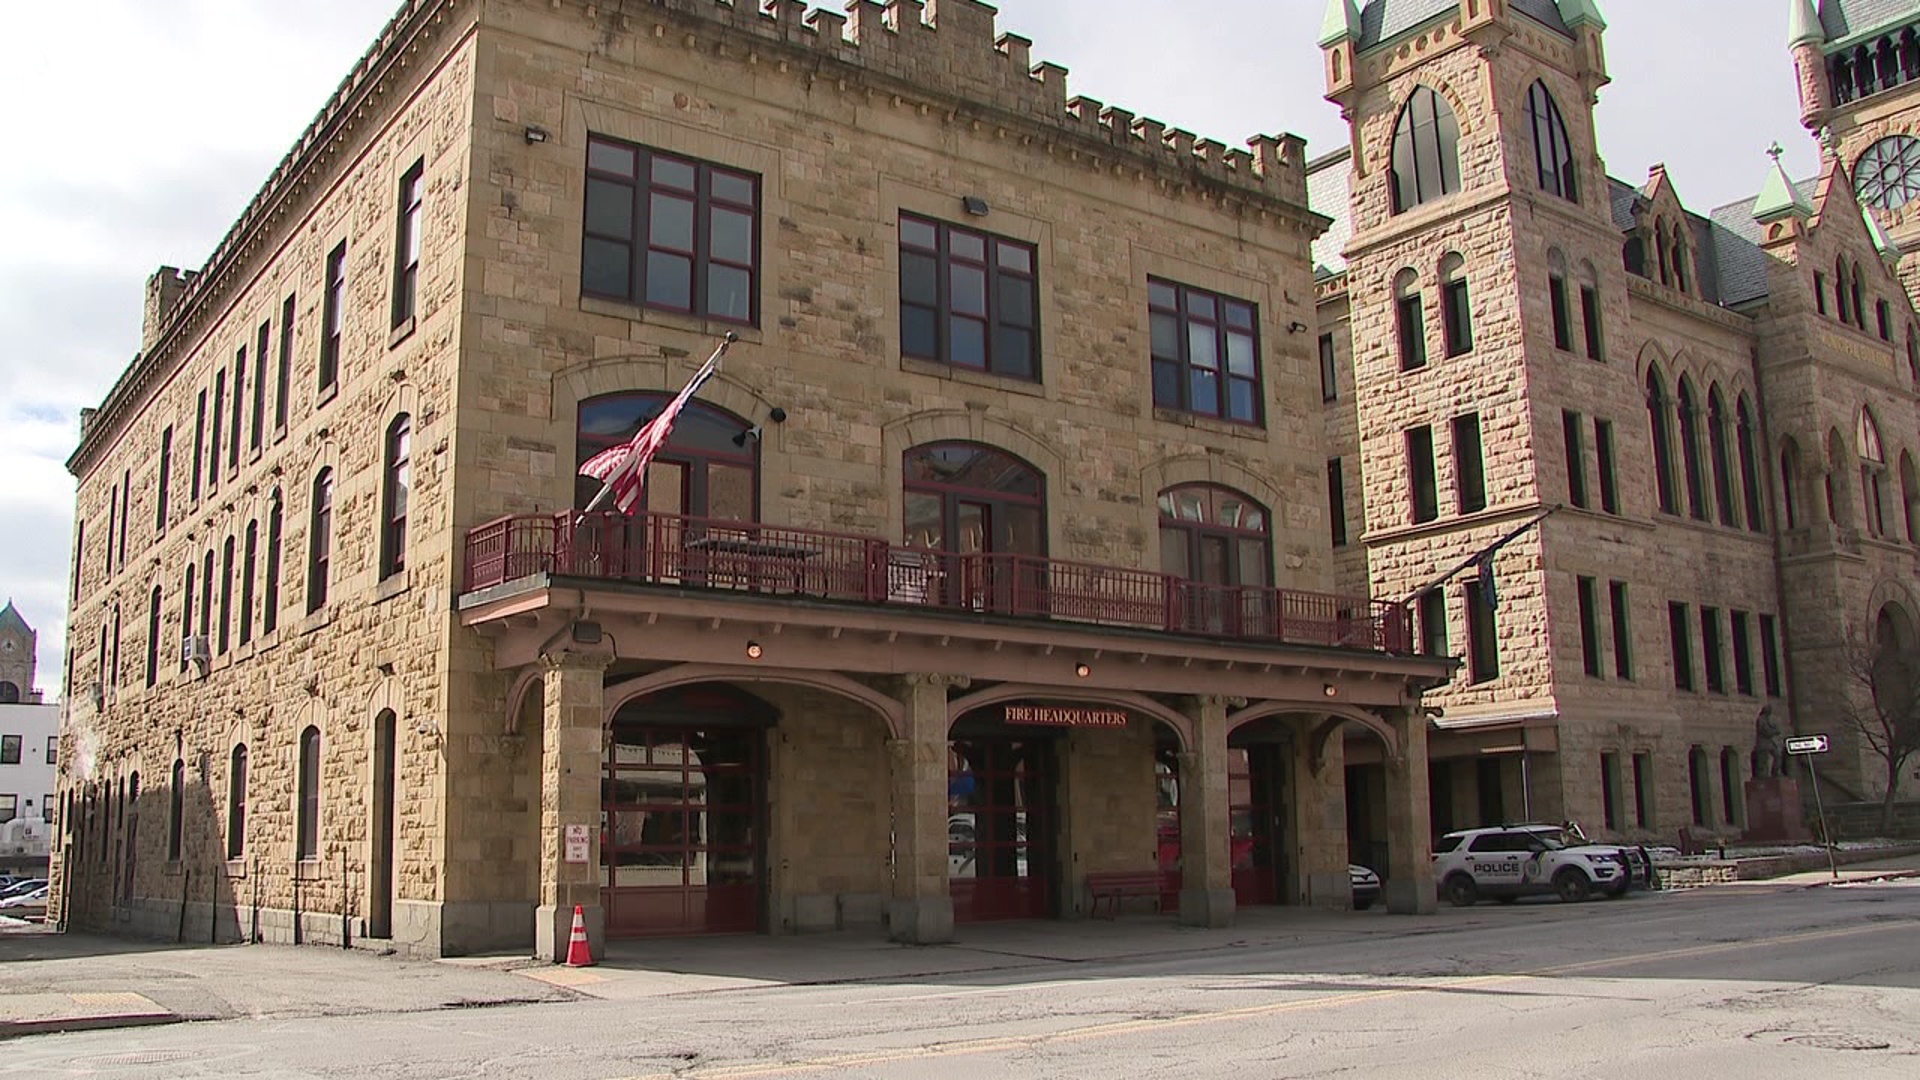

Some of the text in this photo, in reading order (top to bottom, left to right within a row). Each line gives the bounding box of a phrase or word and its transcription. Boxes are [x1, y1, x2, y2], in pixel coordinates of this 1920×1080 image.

[1005, 707, 1126, 724] FIRE HEADQUARTERS
[573, 826, 582, 835] NO
[1474, 863, 1519, 872] POLICE
